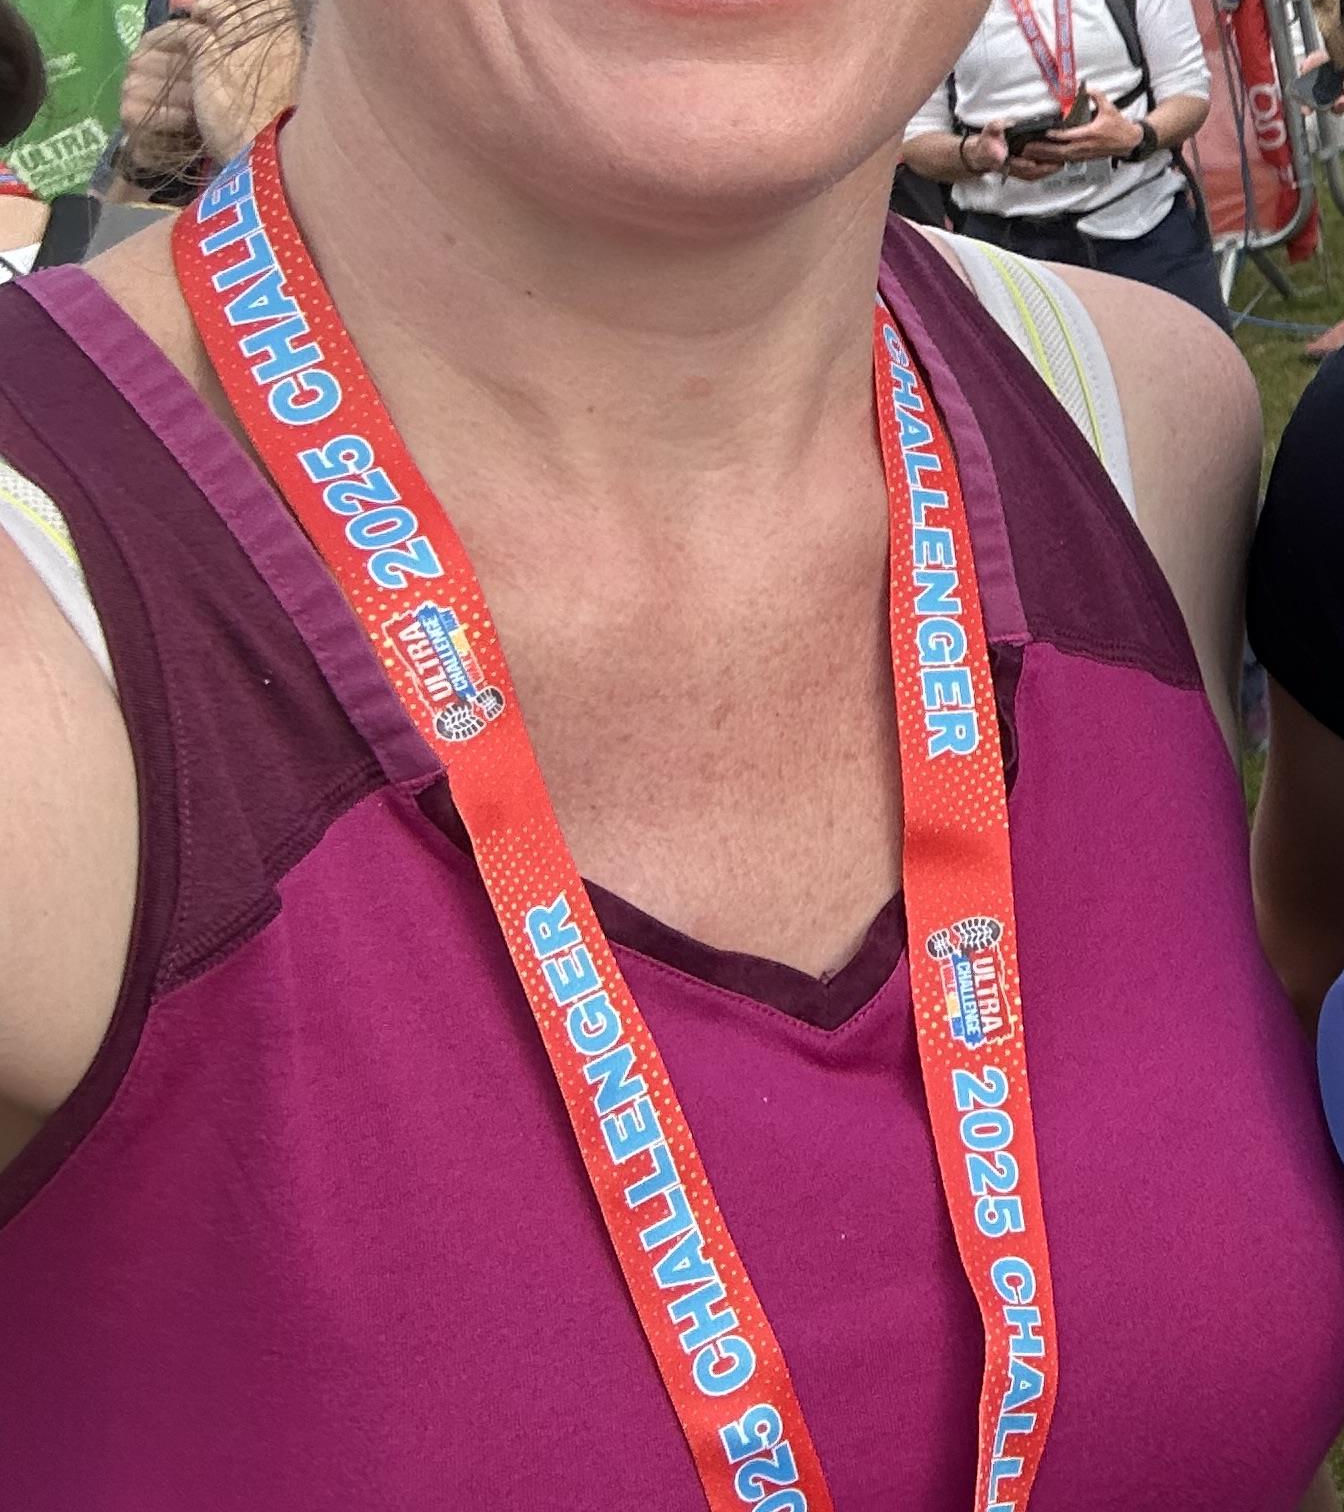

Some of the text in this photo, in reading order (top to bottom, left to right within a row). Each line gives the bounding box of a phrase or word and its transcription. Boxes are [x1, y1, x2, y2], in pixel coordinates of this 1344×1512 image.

[296, 434, 444, 590] 2025
[881, 322, 981, 763] CHALLENGER
[398, 621, 456, 711] ULTRA
[421, 613, 474, 694] CHALLENGE
[955, 960, 981, 1038] CHALLENGE
[969, 955, 1003, 1035] ULTRA
[524, 892, 757, 1399] CHALLENGER
[951, 1063, 1046, 1512] 2025 CHALL
